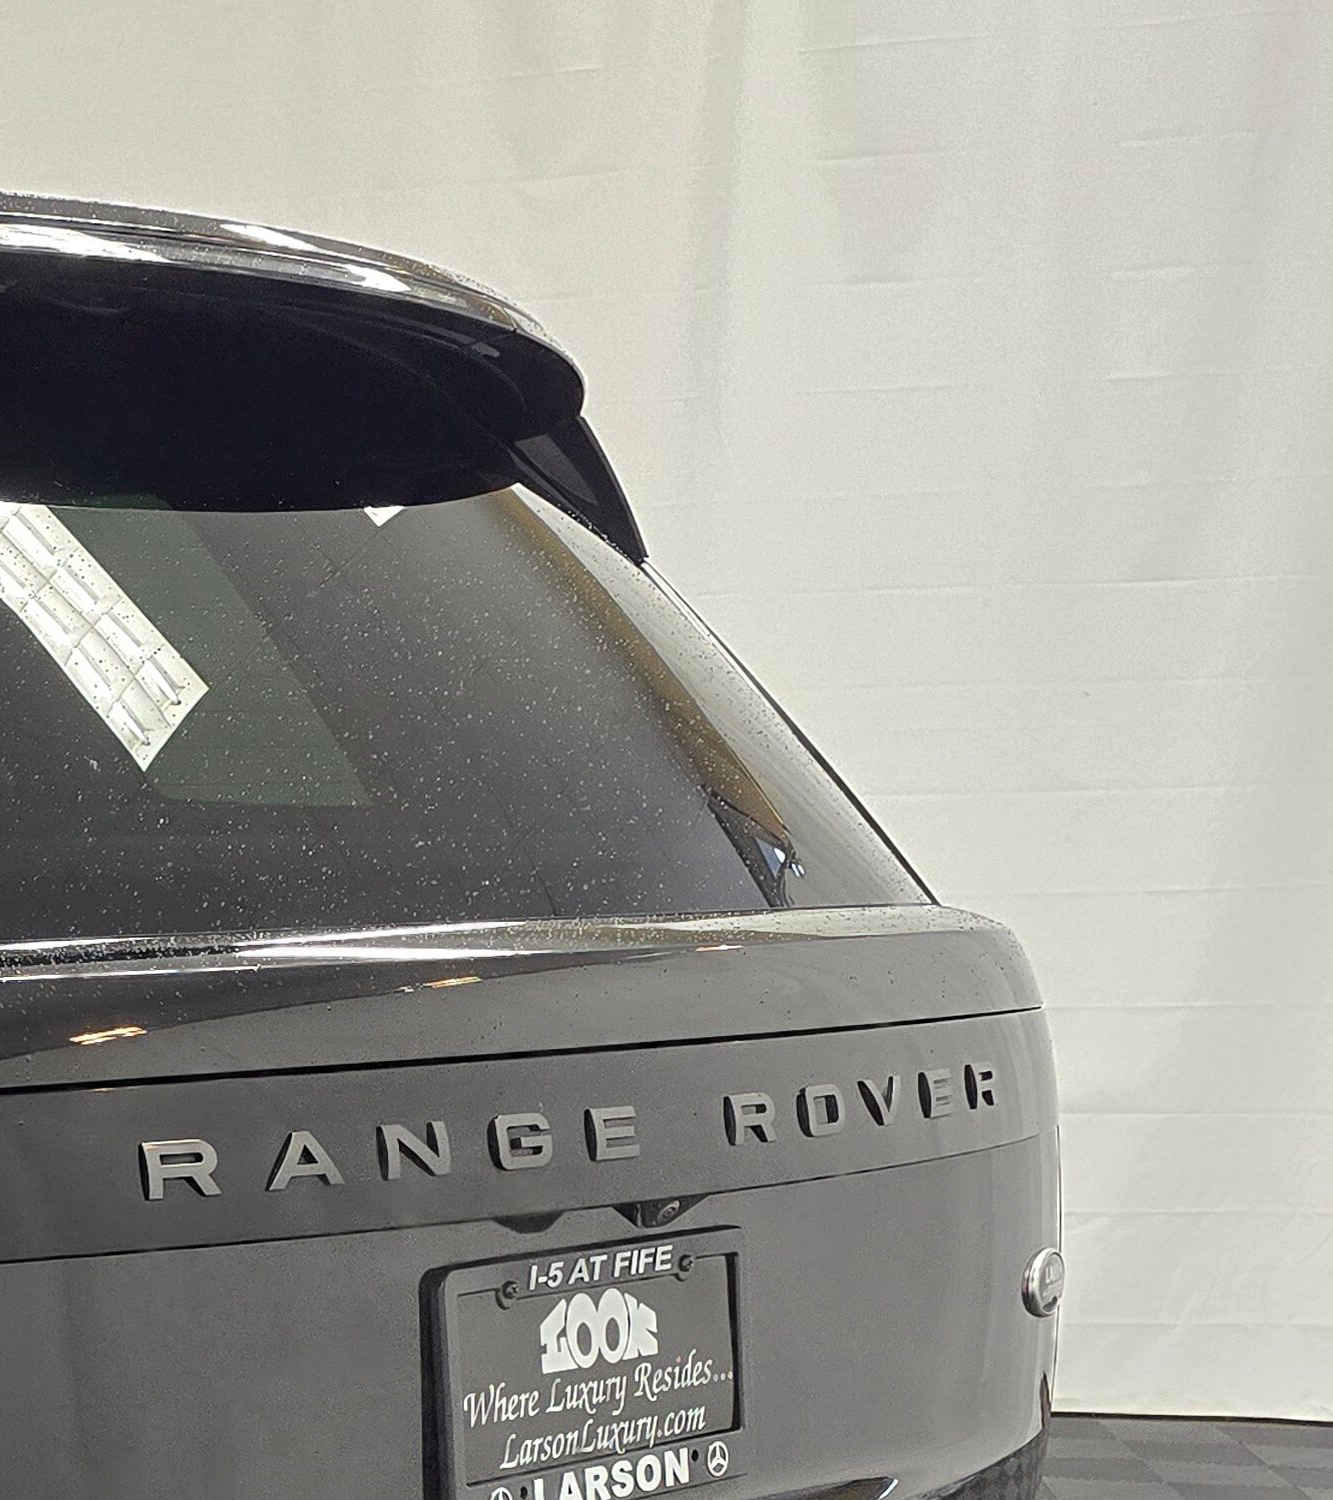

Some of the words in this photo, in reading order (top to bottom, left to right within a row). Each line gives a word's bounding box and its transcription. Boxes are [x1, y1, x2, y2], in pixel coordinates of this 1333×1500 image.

[140, 1104, 639, 1201] RANGE
[725, 1063, 996, 1145] ROVER
[529, 1261, 563, 1290] I-5
[569, 1253, 607, 1285] AT
[614, 1245, 673, 1277] FIFE
[464, 1381, 539, 1428] Where
[546, 1374, 627, 1416] Luxury
[634, 1349, 733, 1401] Resides...
[500, 1404, 707, 1469] LarsonLuxury.com
